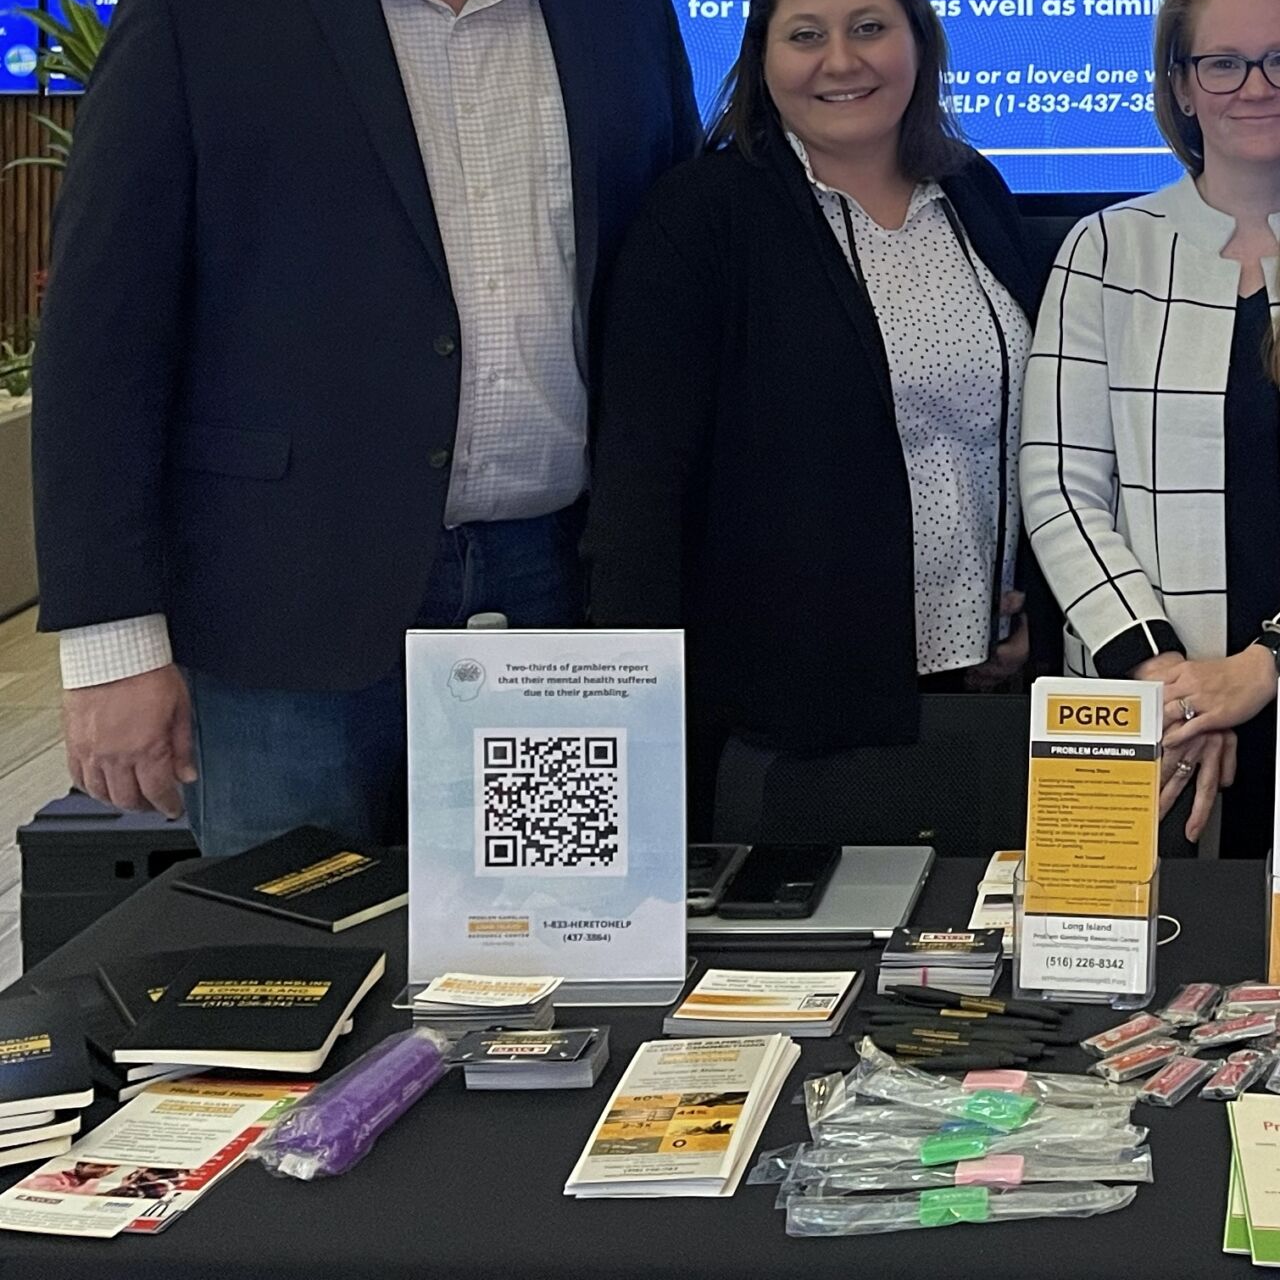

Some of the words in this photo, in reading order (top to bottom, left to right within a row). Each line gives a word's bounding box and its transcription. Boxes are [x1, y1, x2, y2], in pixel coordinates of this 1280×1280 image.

[975, 70, 1002, 84] or
[1006, 70, 1022, 84] a
[1026, 64, 1091, 84] loved
[1095, 70, 1138, 84] one
[994, 92, 1156, 118] (1-833-437-38
[506, 663, 557, 672] Two-thirds
[559, 663, 570, 671] of
[571, 663, 616, 673] gamblers
[618, 664, 649, 673] report
[498, 676, 519, 684] that
[521, 676, 544, 684] their
[546, 676, 582, 684] mental
[583, 676, 615, 684] health
[617, 676, 657, 684] suffered
[523, 689, 542, 697] due
[544, 689, 555, 697] to
[557, 689, 580, 697] their
[1059, 705, 1129, 727] PGRC
[1051, 745, 1091, 755] PROBLEM
[1092, 747, 1136, 757] GAMBLING
[1062, 922, 1084, 932] Long
[1086, 922, 1112, 931] Island
[1045, 956, 1073, 969] (516)
[1075, 957, 1125, 970] 226-8342
